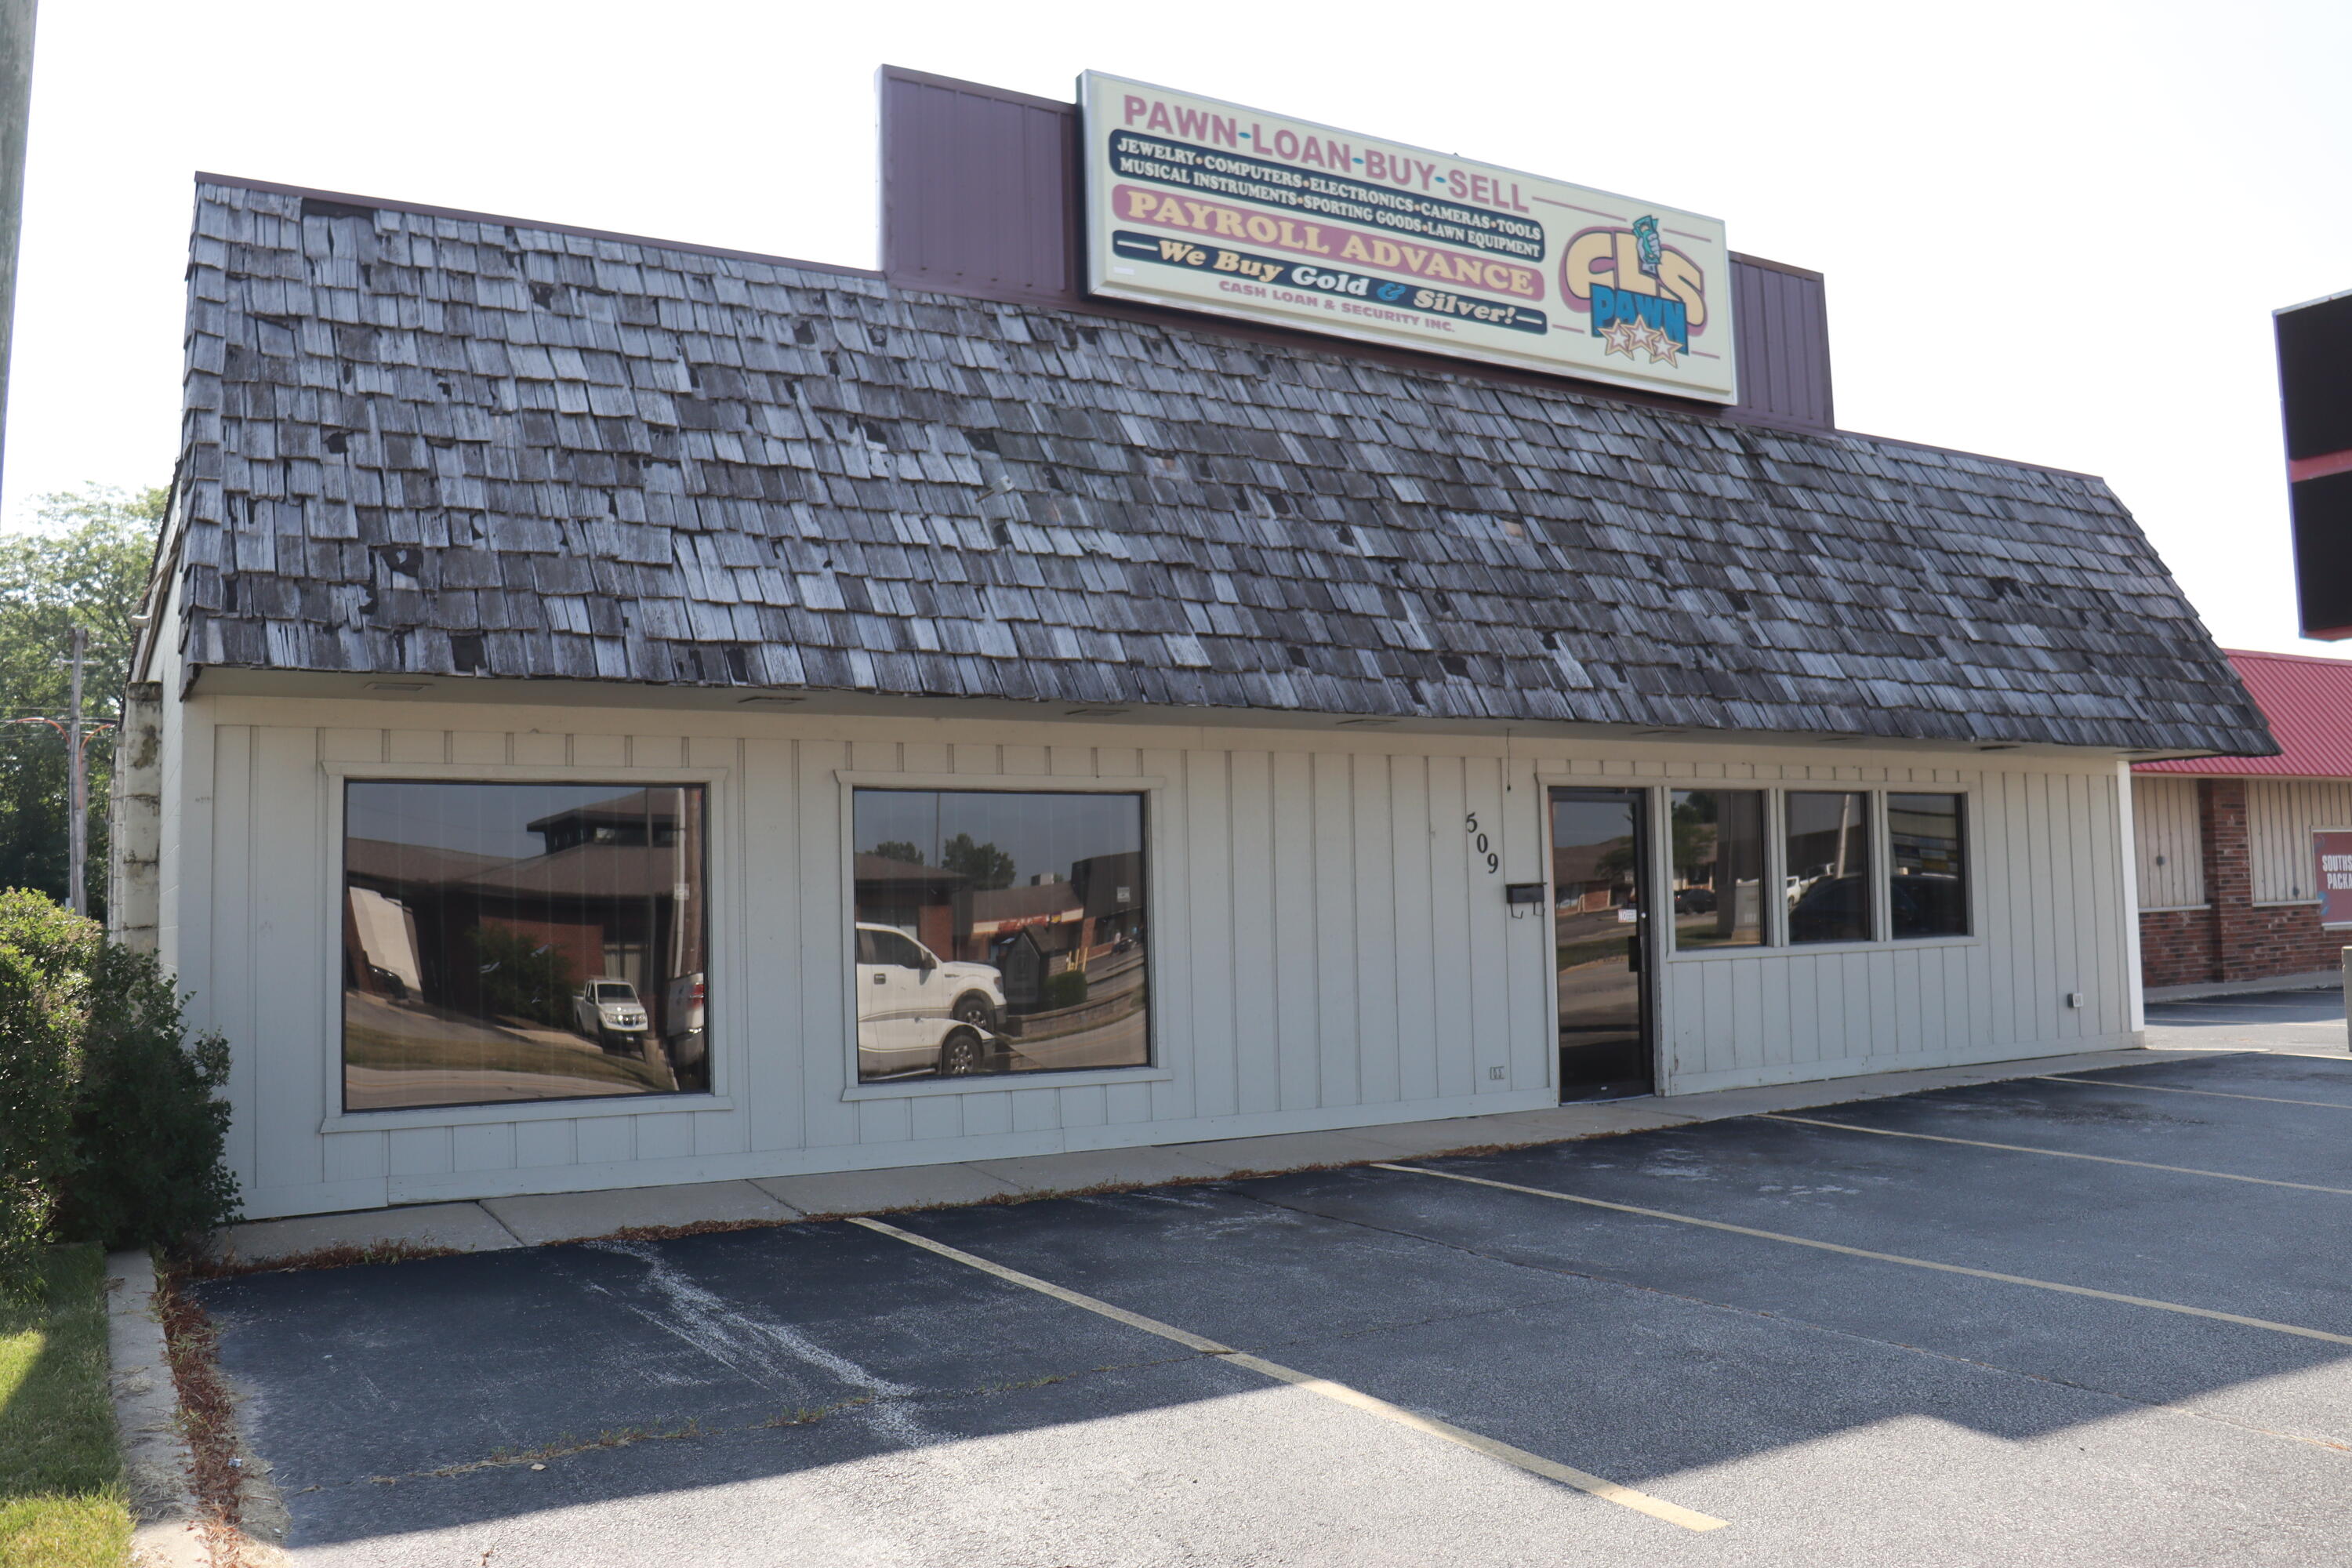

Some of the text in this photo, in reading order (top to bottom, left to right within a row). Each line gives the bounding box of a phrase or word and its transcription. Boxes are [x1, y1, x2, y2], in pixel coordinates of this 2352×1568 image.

[1120, 158, 1190, 184] MUSICAL
[1468, 231, 1541, 258] EQUIPMENT
[1127, 191, 1534, 296] PAYROLL ADVANCE
[1159, 240, 1516, 325] We Buy Gold & Silver!
[1219, 280, 1455, 333] CASH LOAN & SECURITY INC.
[1590, 281, 1690, 357] PAWN
[1465, 811, 1498, 874] 509
